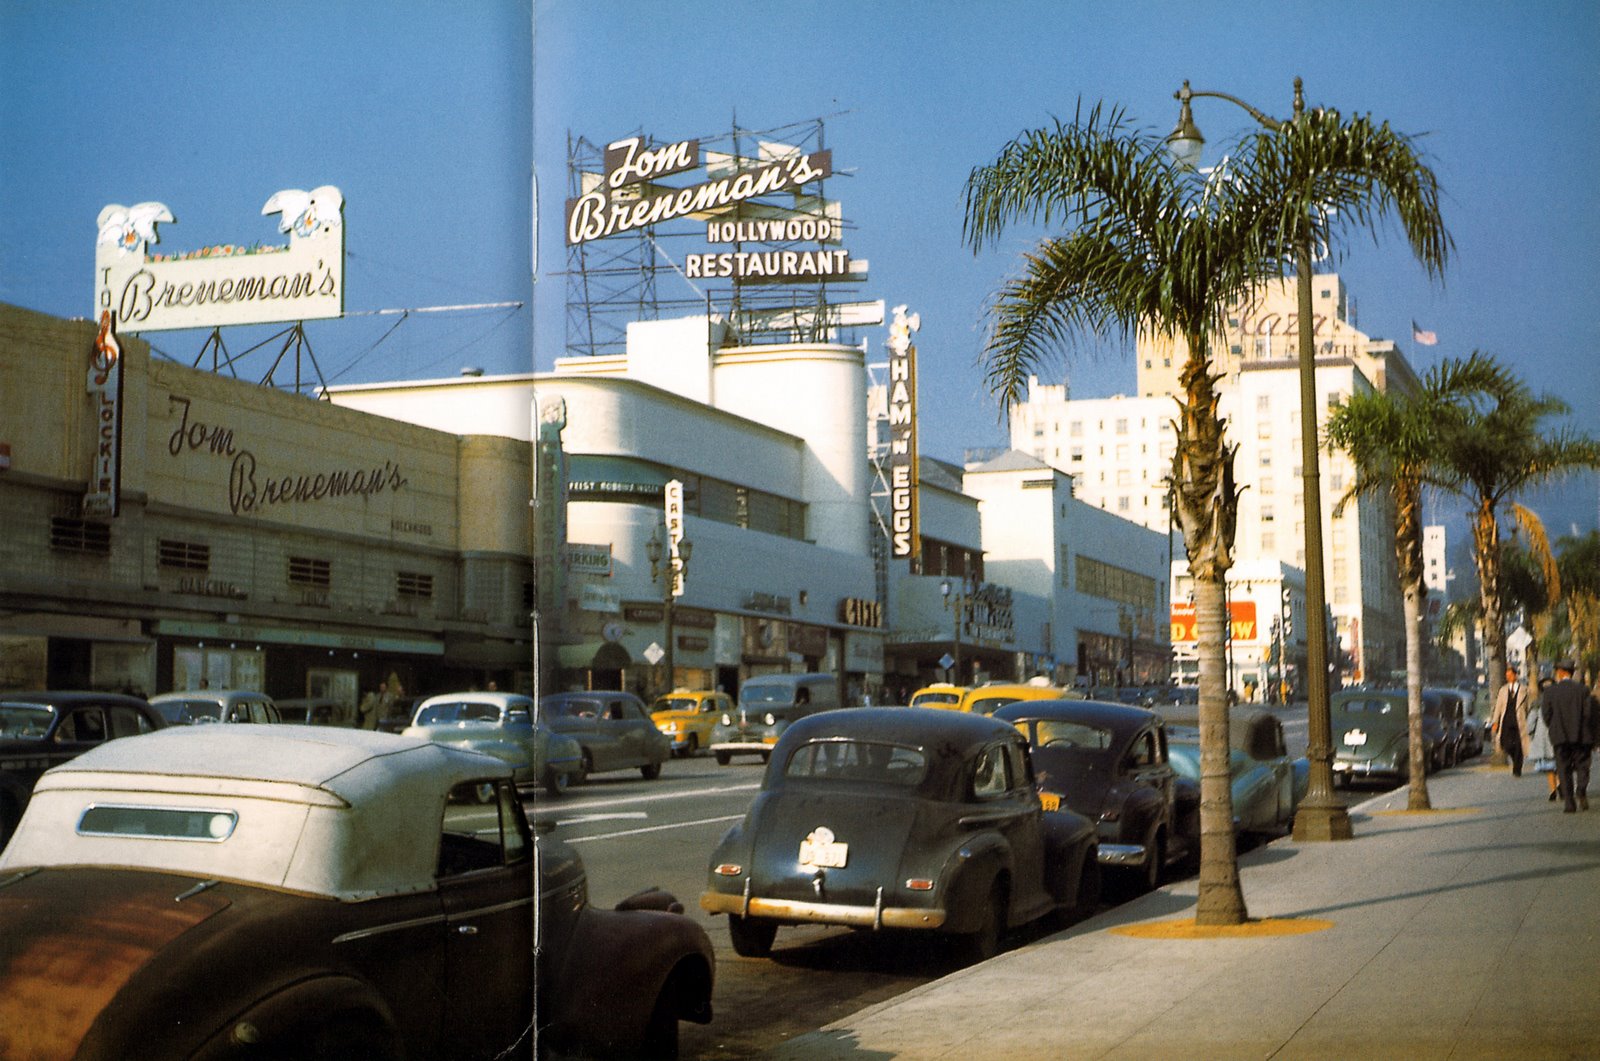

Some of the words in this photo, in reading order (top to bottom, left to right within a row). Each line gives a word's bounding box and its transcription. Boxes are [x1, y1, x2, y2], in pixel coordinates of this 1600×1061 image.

[608, 136, 692, 187] Tom
[569, 153, 823, 245] Breneman's
[707, 219, 832, 243] HOLLYWOOD
[118, 258, 336, 324] Breneman's
[685, 249, 848, 279] RESTAURANT
[890, 357, 912, 426] HAM
[168, 394, 236, 457] Tom
[229, 450, 408, 515] Breneman's
[892, 465, 911, 556] EGGS
